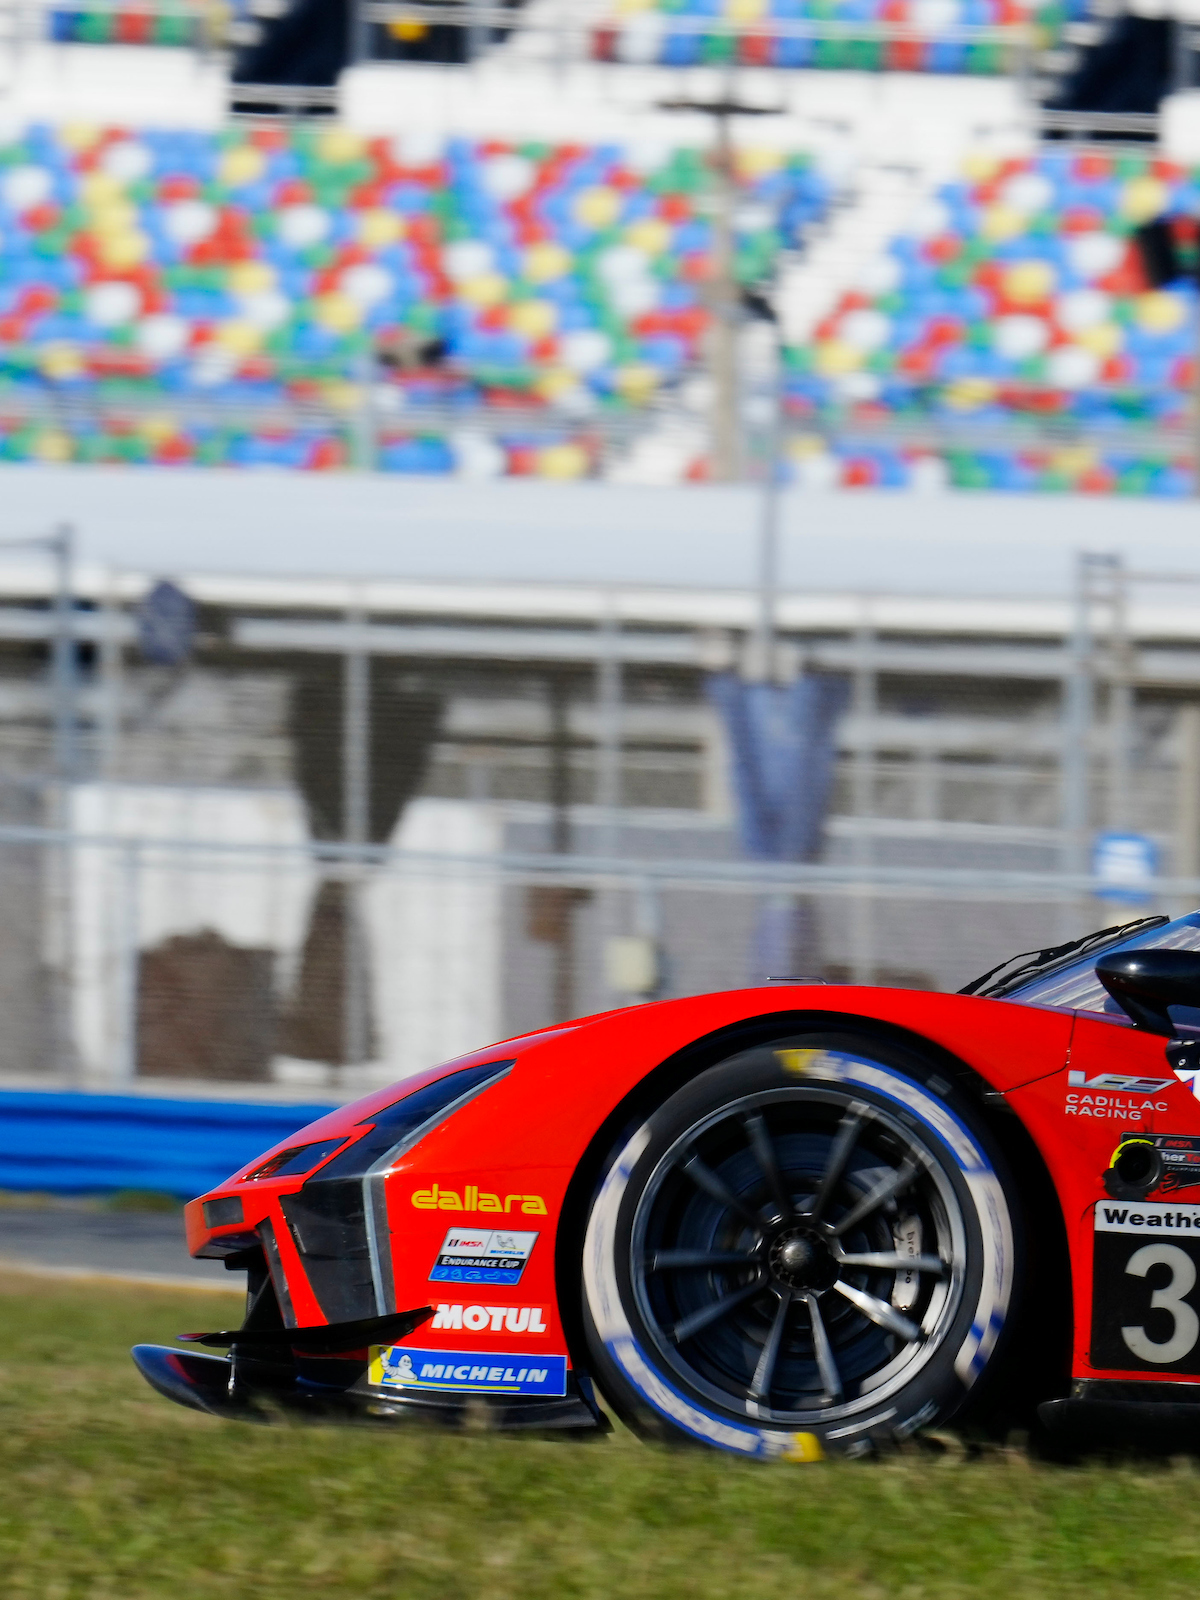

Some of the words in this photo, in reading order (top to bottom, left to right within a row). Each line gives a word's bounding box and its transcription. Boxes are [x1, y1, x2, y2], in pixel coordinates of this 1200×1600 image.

[1065, 1093, 1169, 1112] CADILLAC
[1064, 1104, 1142, 1121] RACING
[410, 1183, 549, 1216] dallara
[458, 1240, 485, 1248] IMSA
[431, 1303, 547, 1333] MOTUL
[419, 1363, 548, 1383] MICHELIN
